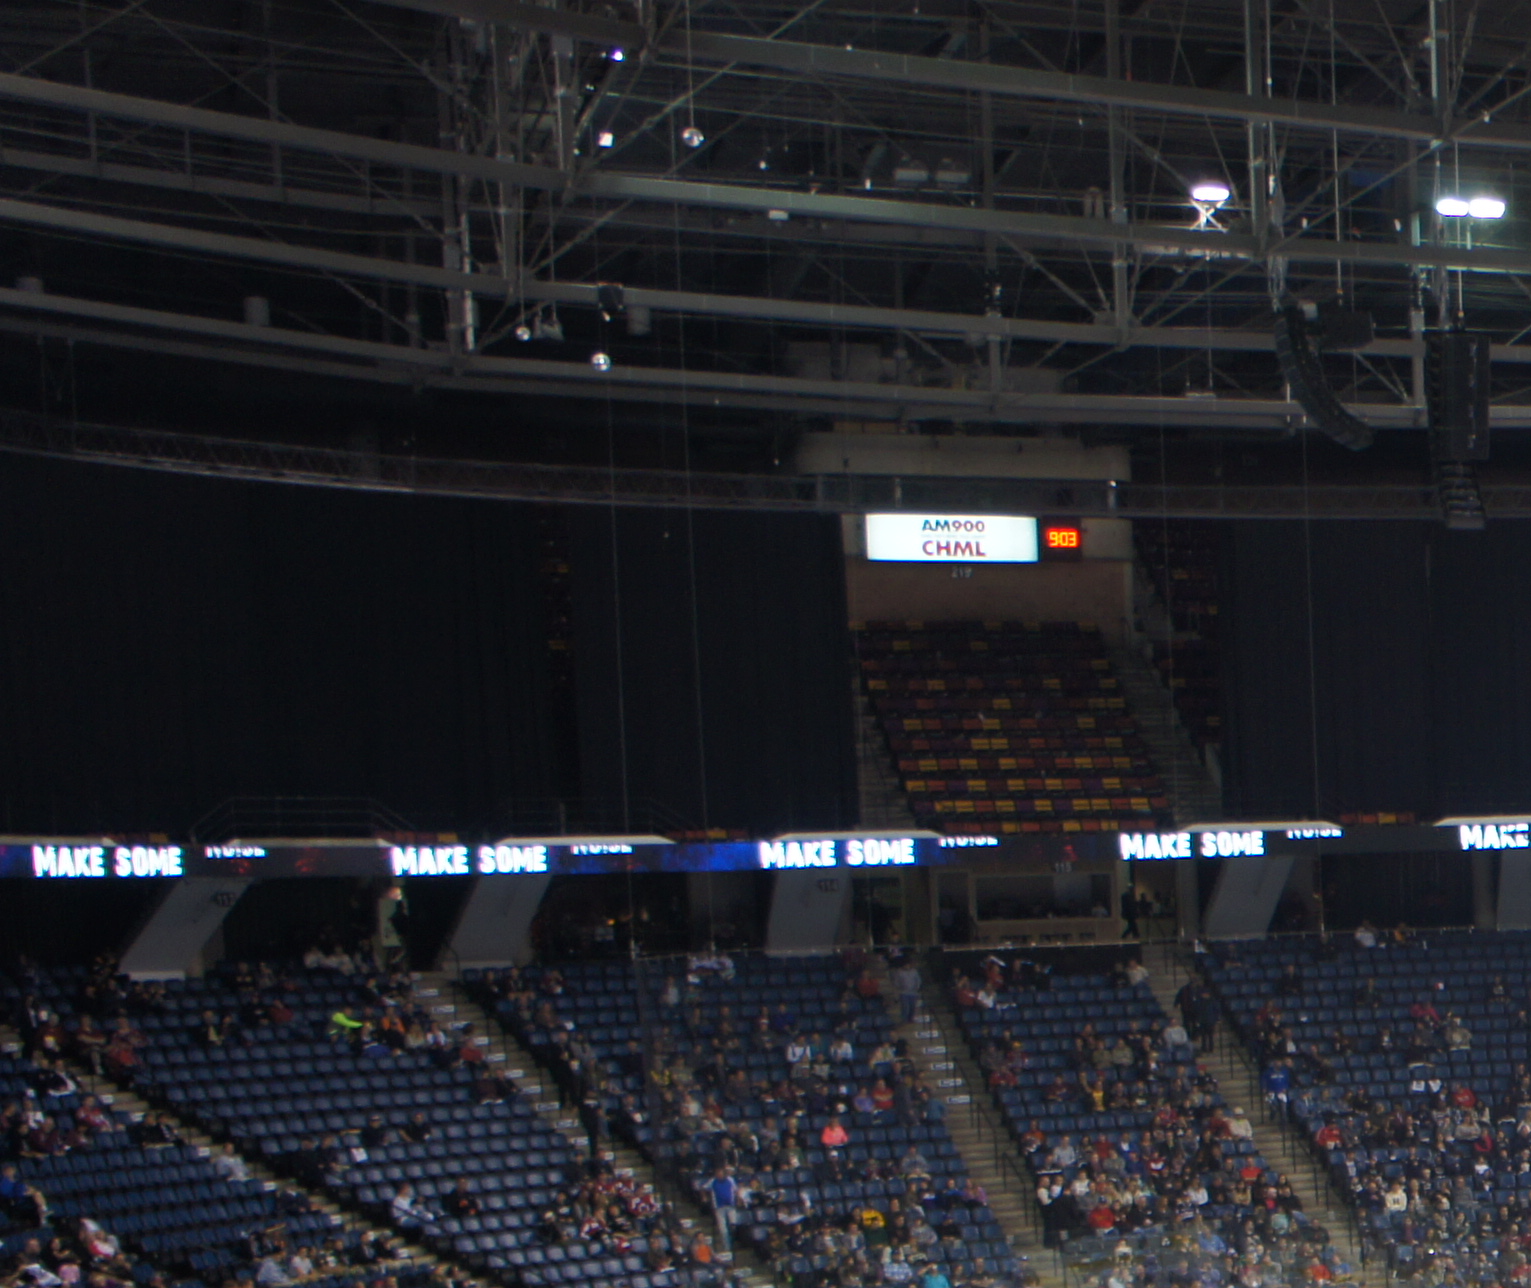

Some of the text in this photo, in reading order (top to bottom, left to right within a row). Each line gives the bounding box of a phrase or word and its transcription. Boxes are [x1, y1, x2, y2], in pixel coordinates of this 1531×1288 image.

[922, 519, 985, 533] AM900
[922, 539, 987, 557] CHML
[1120, 831, 1191, 860] MAKE
[1201, 830, 1264, 857] SOME
[1460, 824, 1530, 851] MAKE
[33, 845, 182, 878] MAKE SOME
[392, 845, 469, 876] MAKE
[480, 844, 548, 875] SOME
[760, 840, 836, 869] MAKE
[847, 838, 915, 866] SOME
